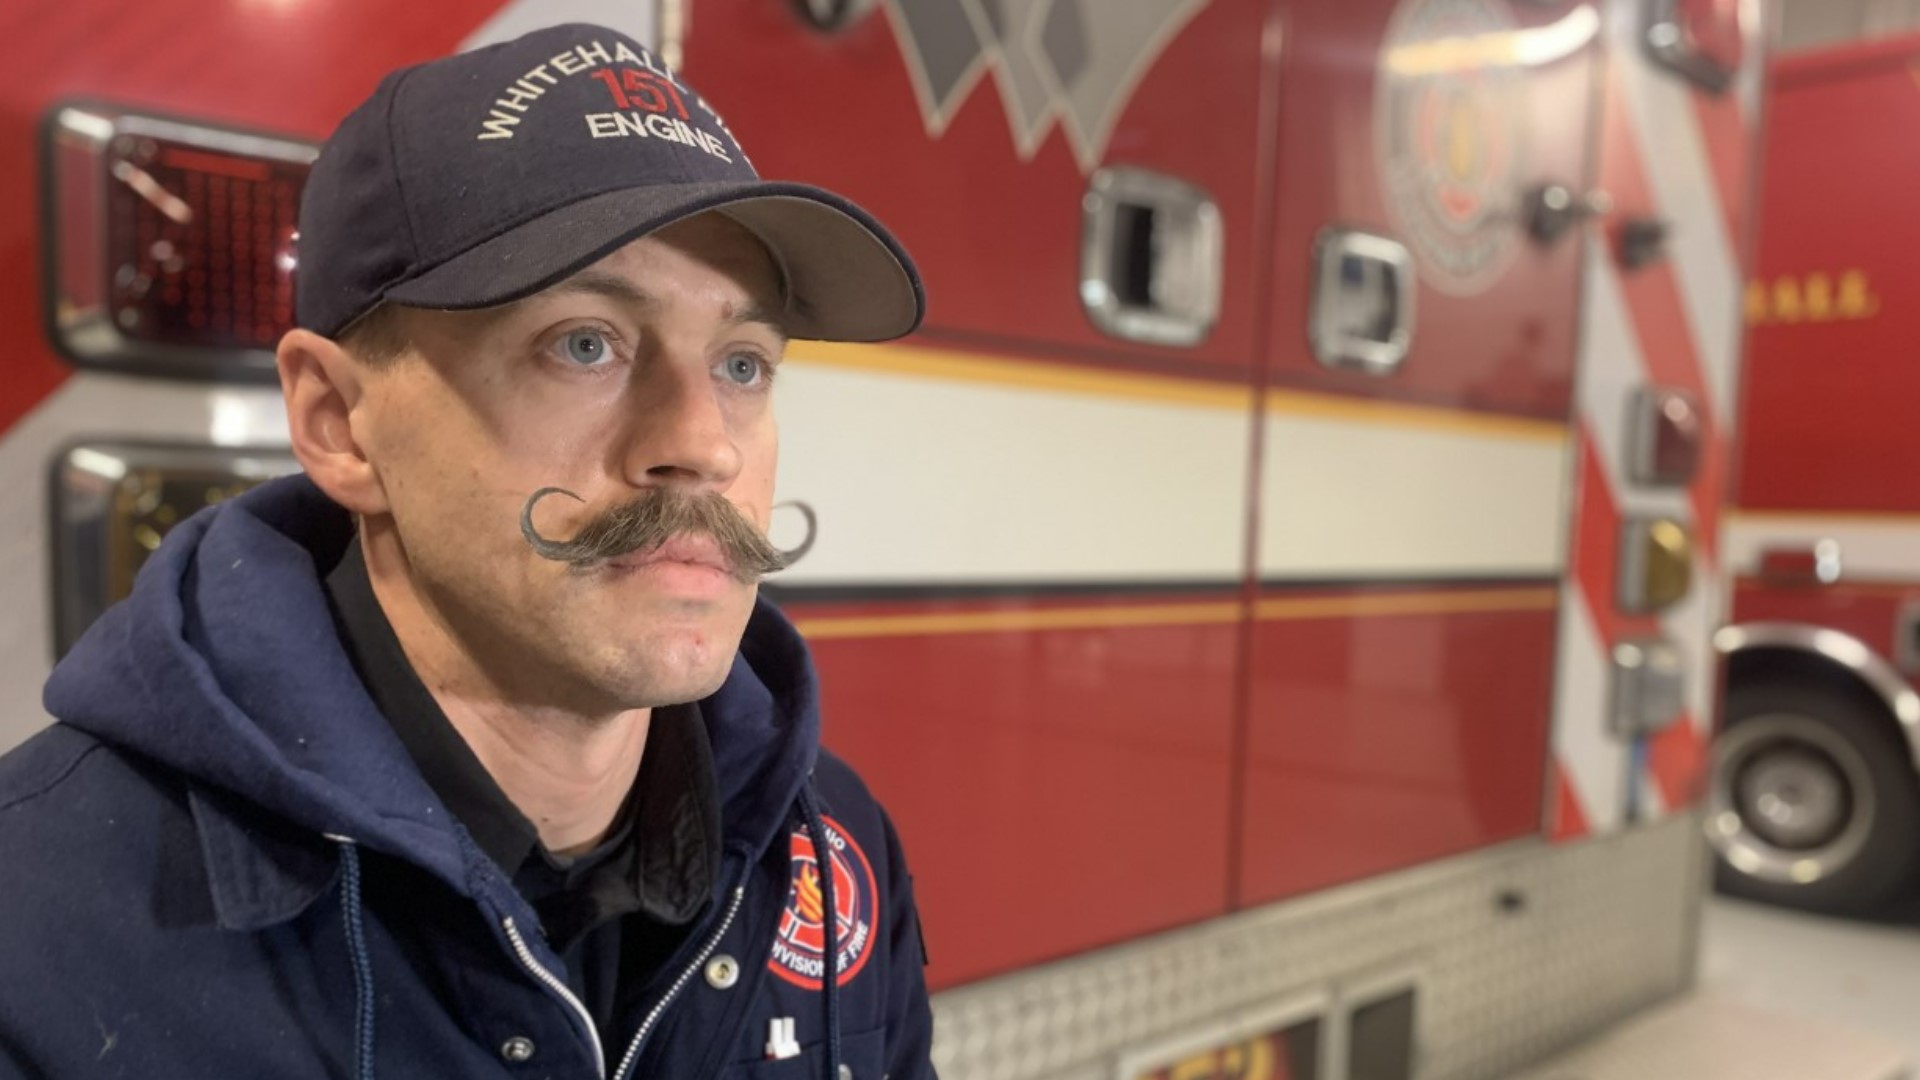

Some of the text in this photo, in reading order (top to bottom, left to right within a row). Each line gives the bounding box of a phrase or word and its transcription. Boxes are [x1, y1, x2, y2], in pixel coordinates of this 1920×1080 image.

[477, 40, 688, 140] WHITEHALL
[590, 68, 690, 121] 151
[584, 111, 733, 164] ENGINE
[771, 938, 825, 978] IVISIO
